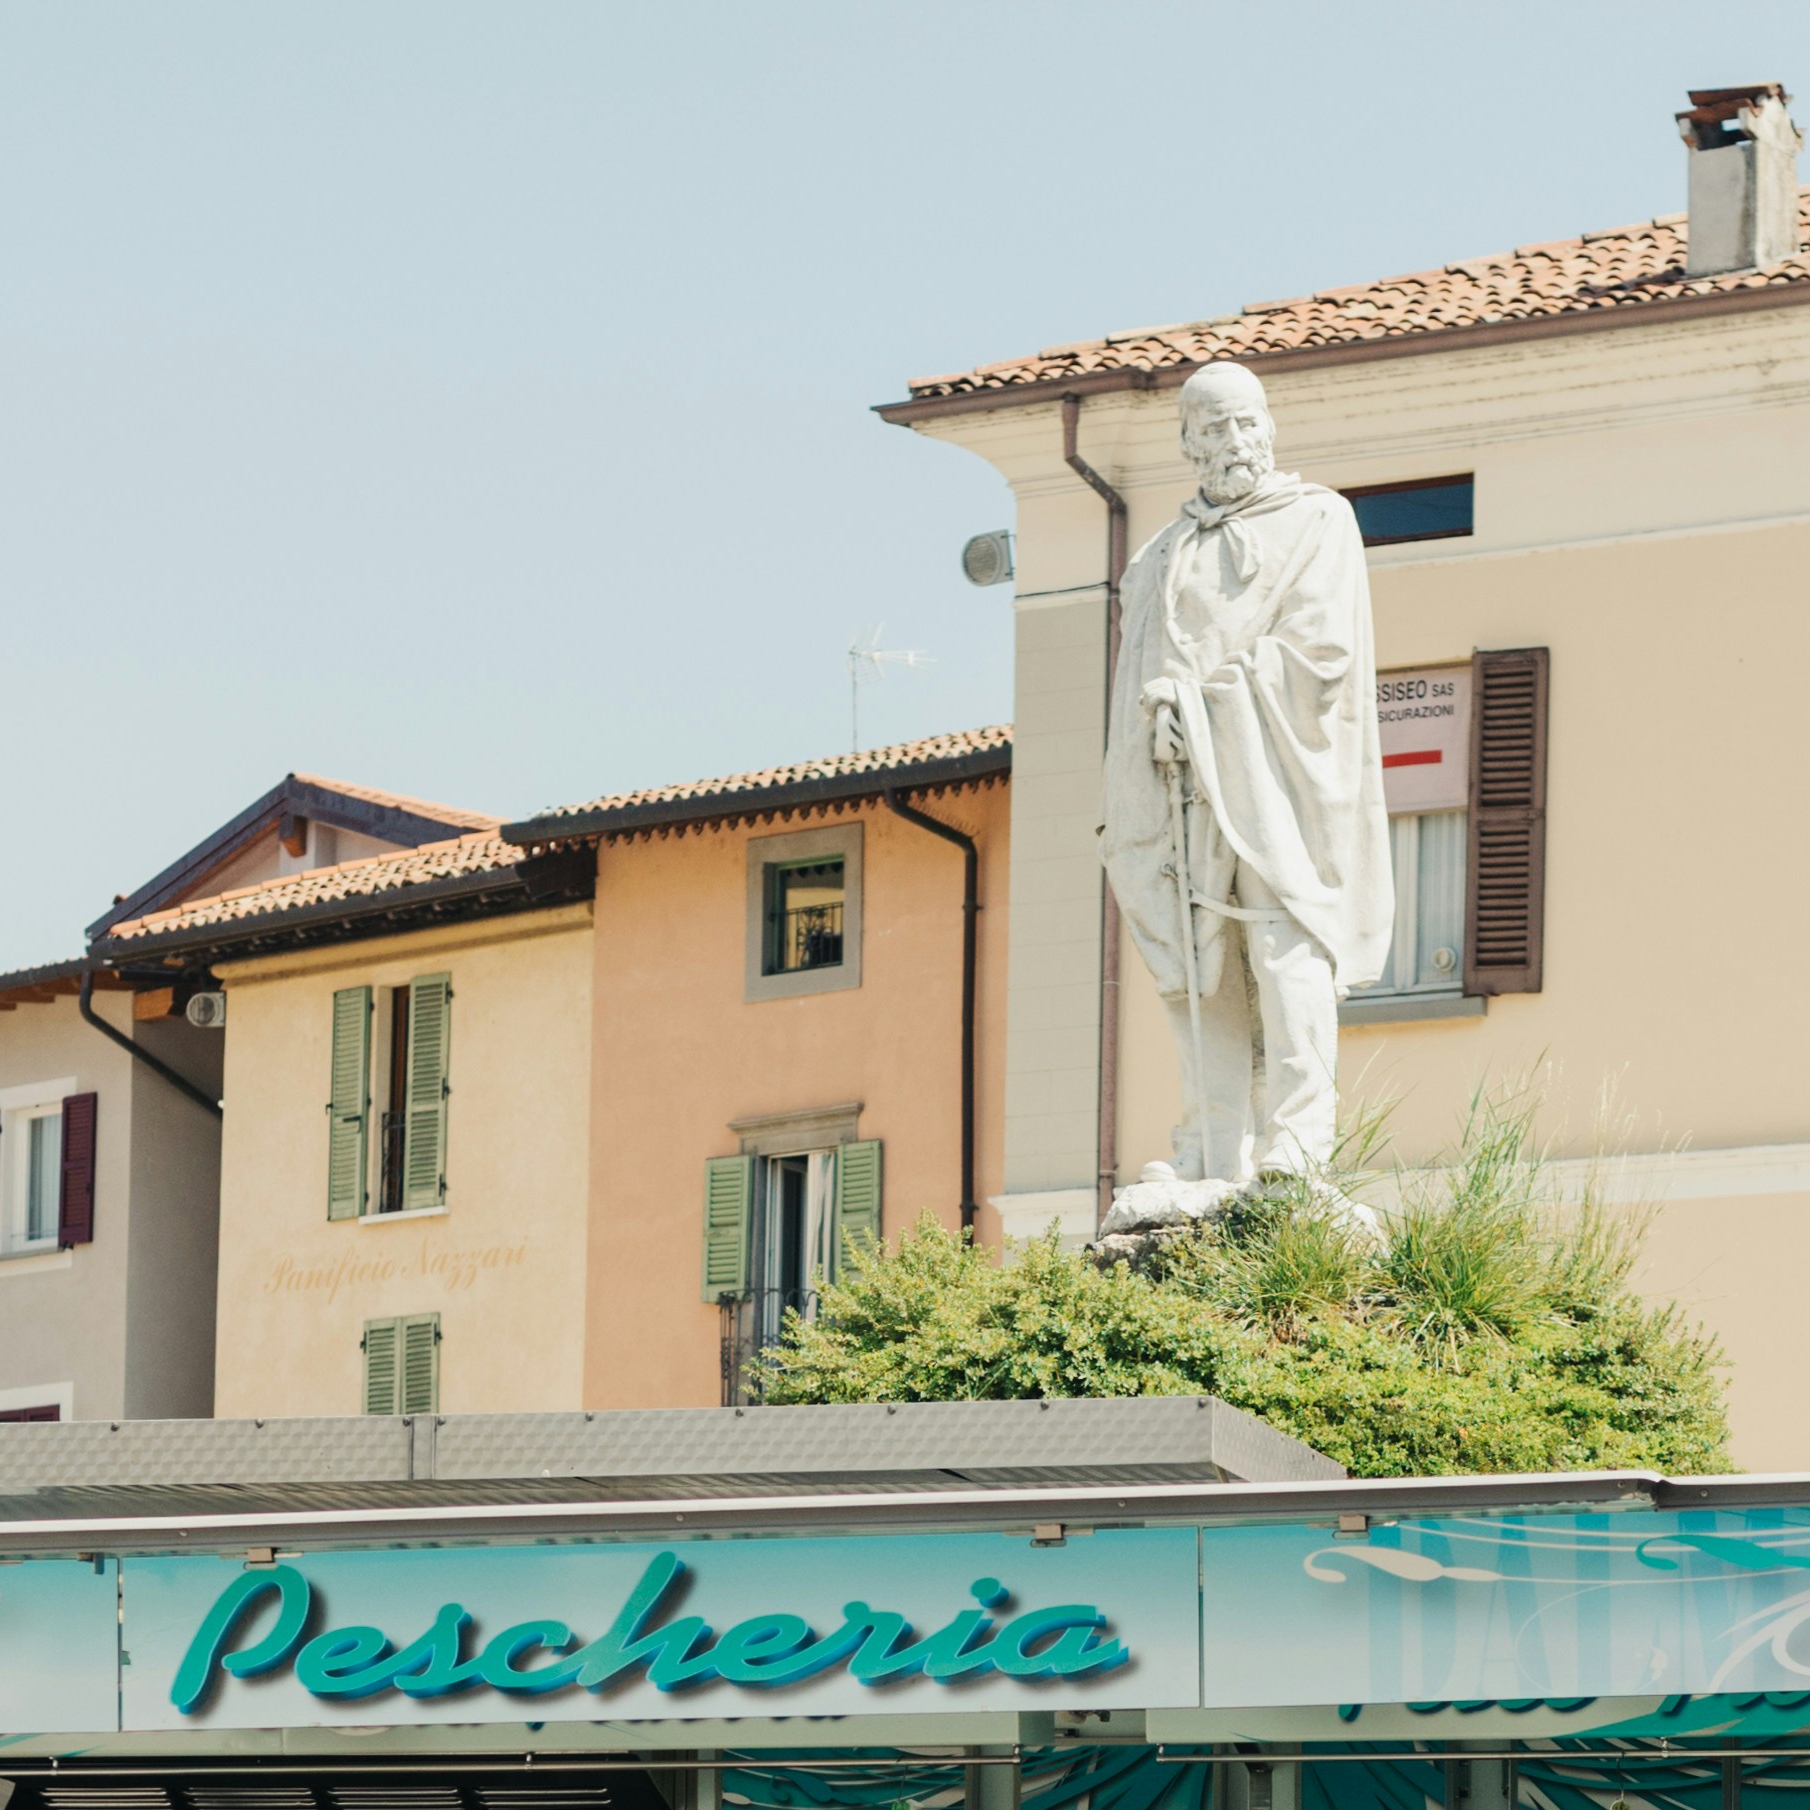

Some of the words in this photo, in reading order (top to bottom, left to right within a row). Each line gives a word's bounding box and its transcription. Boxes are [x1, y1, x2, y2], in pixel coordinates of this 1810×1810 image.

[1432, 682, 1454, 697] SAS
[263, 1245, 399, 1304] Panificio
[170, 1550, 1132, 1717] Pescheria
